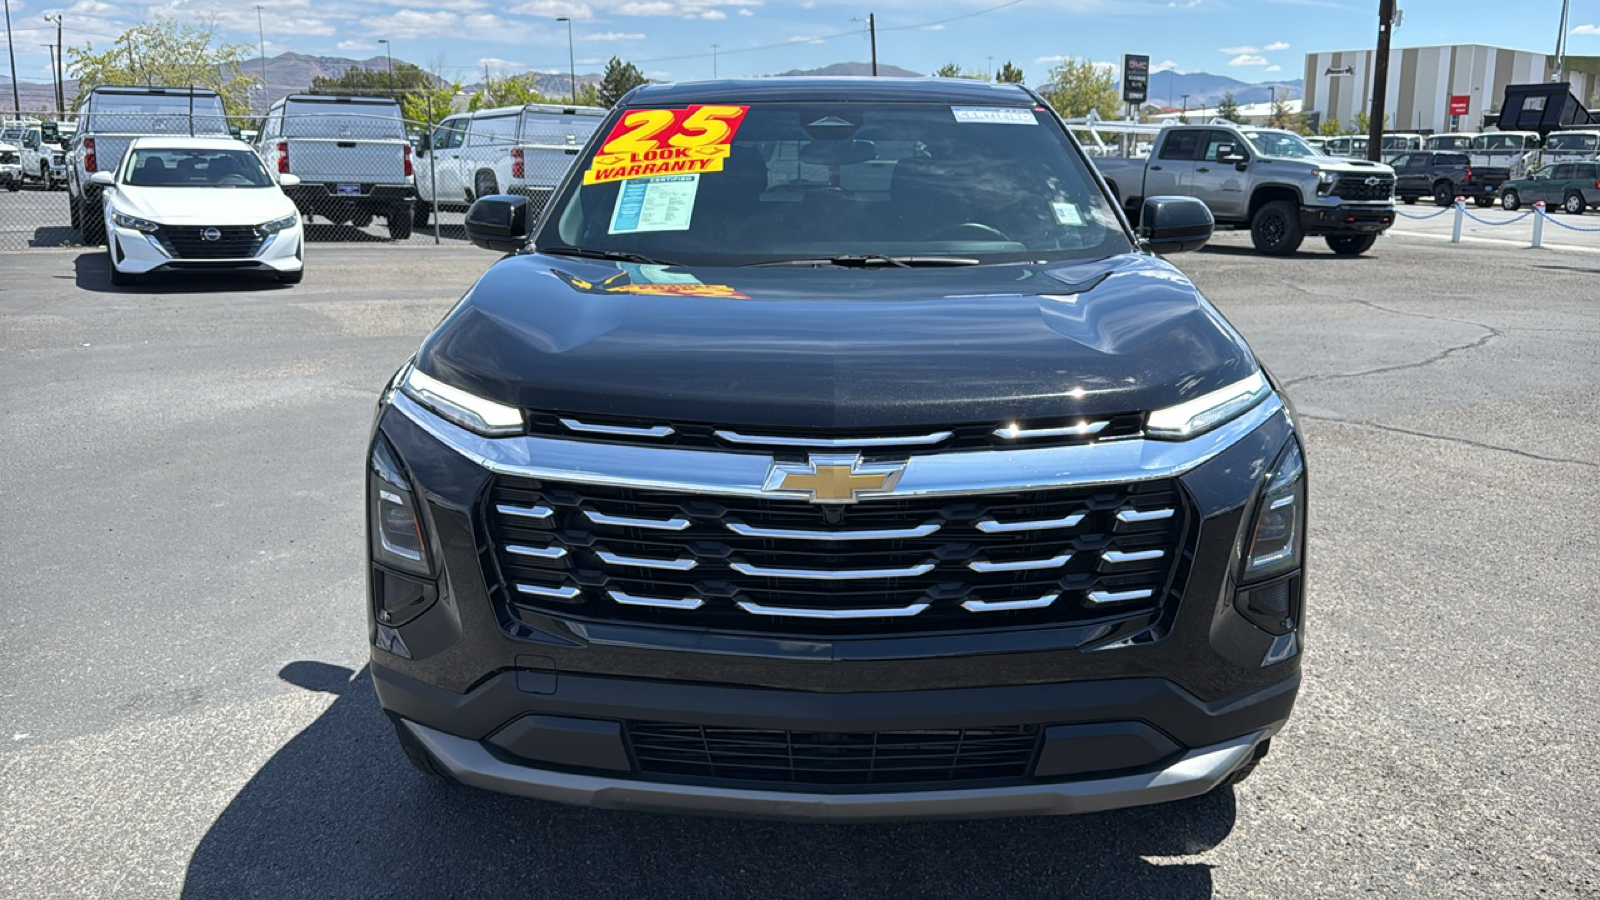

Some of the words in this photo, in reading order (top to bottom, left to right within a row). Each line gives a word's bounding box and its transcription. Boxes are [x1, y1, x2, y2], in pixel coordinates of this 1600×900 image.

[957, 111, 1031, 121] CERTIFIED
[603, 106, 743, 155] 25
[630, 147, 691, 163] LOOK
[594, 158, 715, 181] WARRANTY
